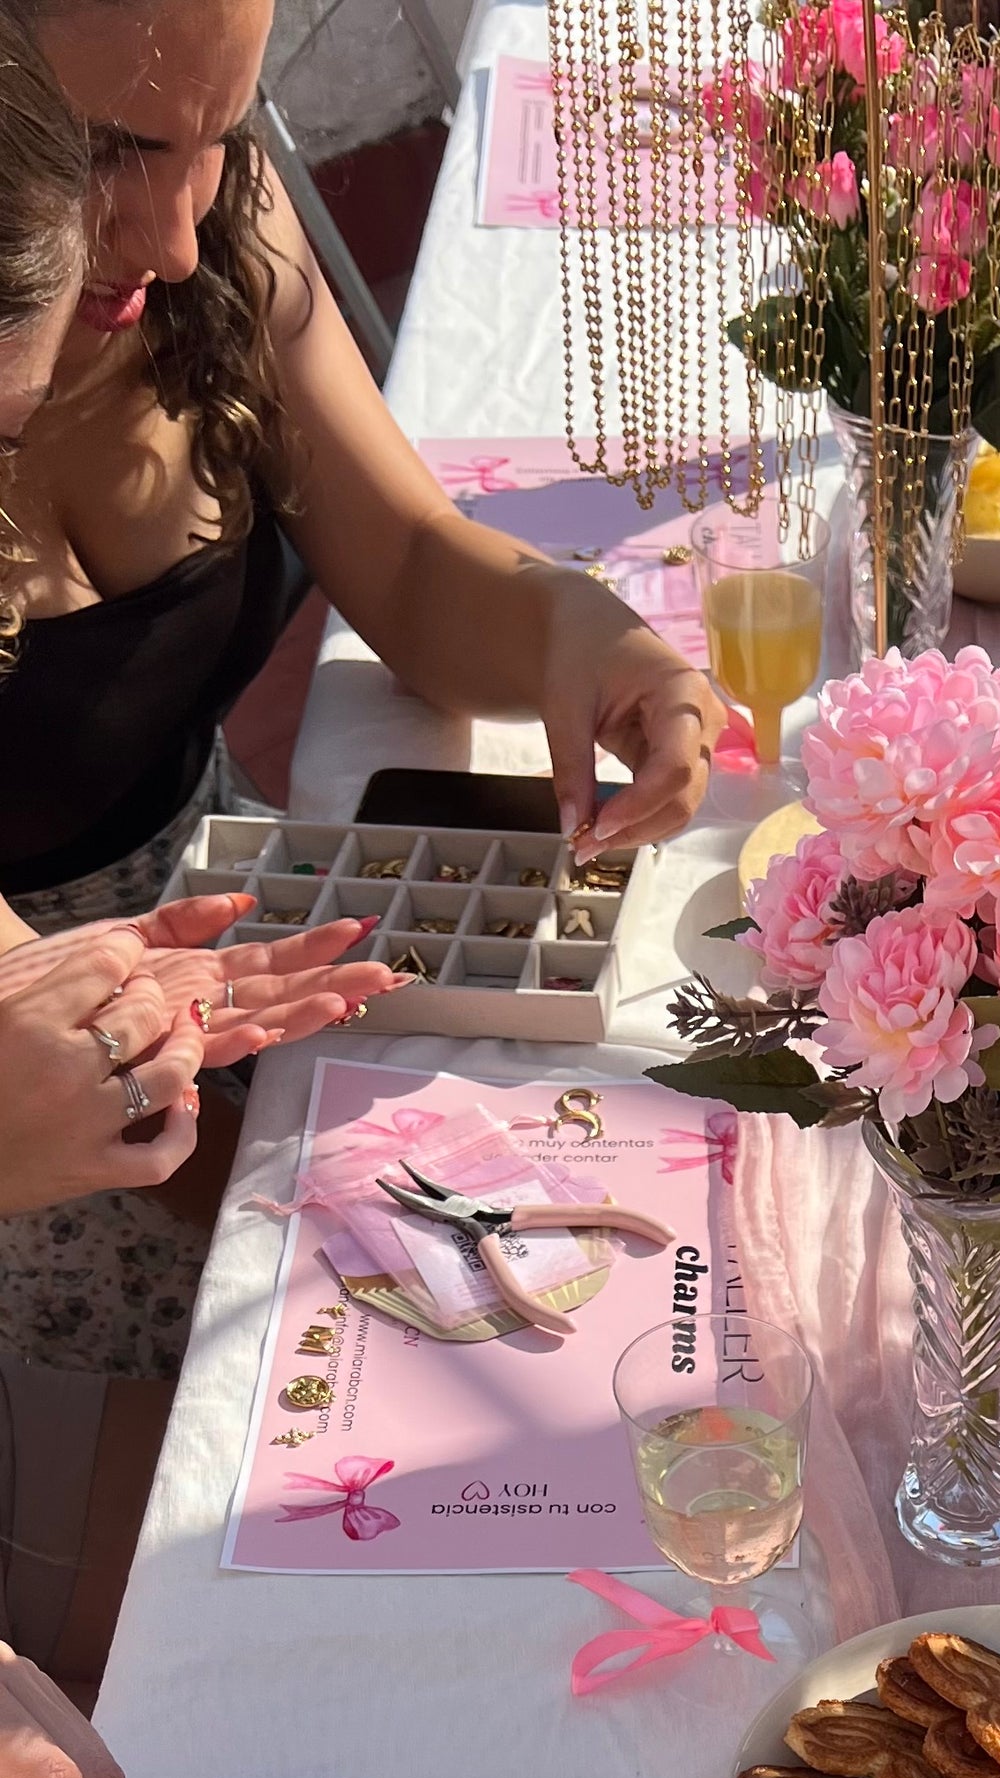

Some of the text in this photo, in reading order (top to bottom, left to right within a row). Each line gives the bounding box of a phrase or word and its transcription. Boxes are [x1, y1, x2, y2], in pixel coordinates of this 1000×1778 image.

[563, 1153, 619, 1163] contar
[498, 1483, 548, 1498] HOY
[431, 1503, 617, 1517] con tu asistencia
